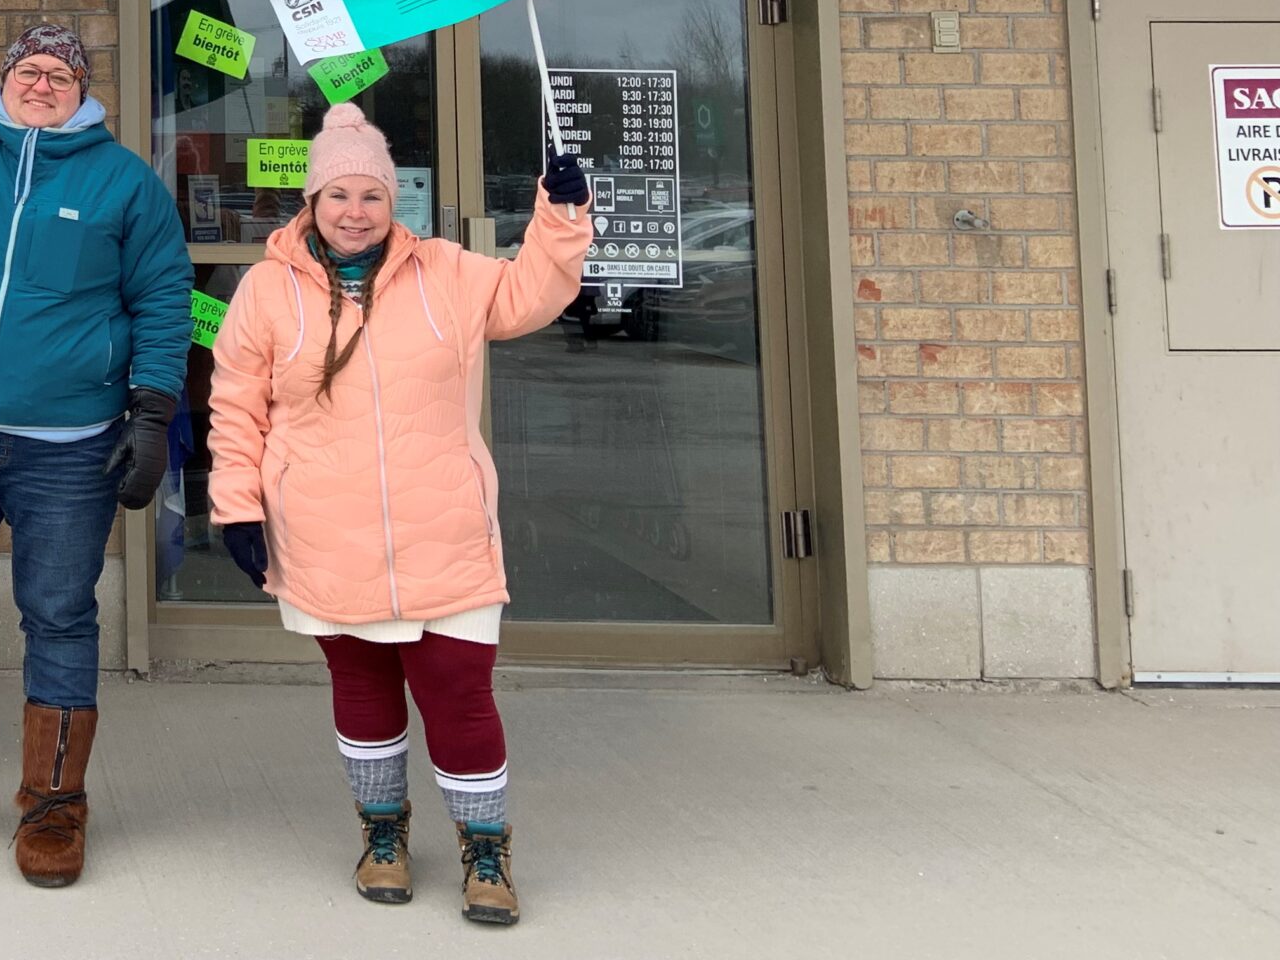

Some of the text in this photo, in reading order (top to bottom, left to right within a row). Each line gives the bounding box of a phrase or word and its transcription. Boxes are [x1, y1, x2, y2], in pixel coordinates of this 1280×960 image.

[292, 1, 324, 22] CSN
[198, 18, 245, 46] En grève
[193, 34, 240, 61] bientôt
[320, 61, 338, 75] En
[330, 56, 375, 88] bientôt
[549, 76, 573, 87] UNDI
[617, 77, 641, 87] 12:00
[647, 77, 672, 88] 17:30
[622, 91, 641, 101] 9:30
[648, 91, 672, 101] 17:30
[554, 103, 592, 114] ERCREDI
[623, 104, 641, 115] 9:30
[648, 105, 672, 115] 17:30
[623, 118, 642, 128] 9:30
[648, 119, 673, 129] 19:00
[548, 130, 591, 141] VNDREDI
[623, 132, 642, 142] 9:30
[648, 132, 673, 142] 21:00
[1236, 125, 1271, 138] AIRE
[259, 143, 308, 158] En grève
[618, 145, 643, 156] 10:00
[649, 146, 673, 156] 17:00
[1228, 148, 1280, 161] LIVRAI
[260, 160, 308, 173] bientôt
[619, 159, 643, 169] 12:00
[649, 159, 674, 170] 17:00
[597, 191, 611, 199] 24/7
[589, 263, 605, 274] 18+
[200, 302, 226, 318] grèv
